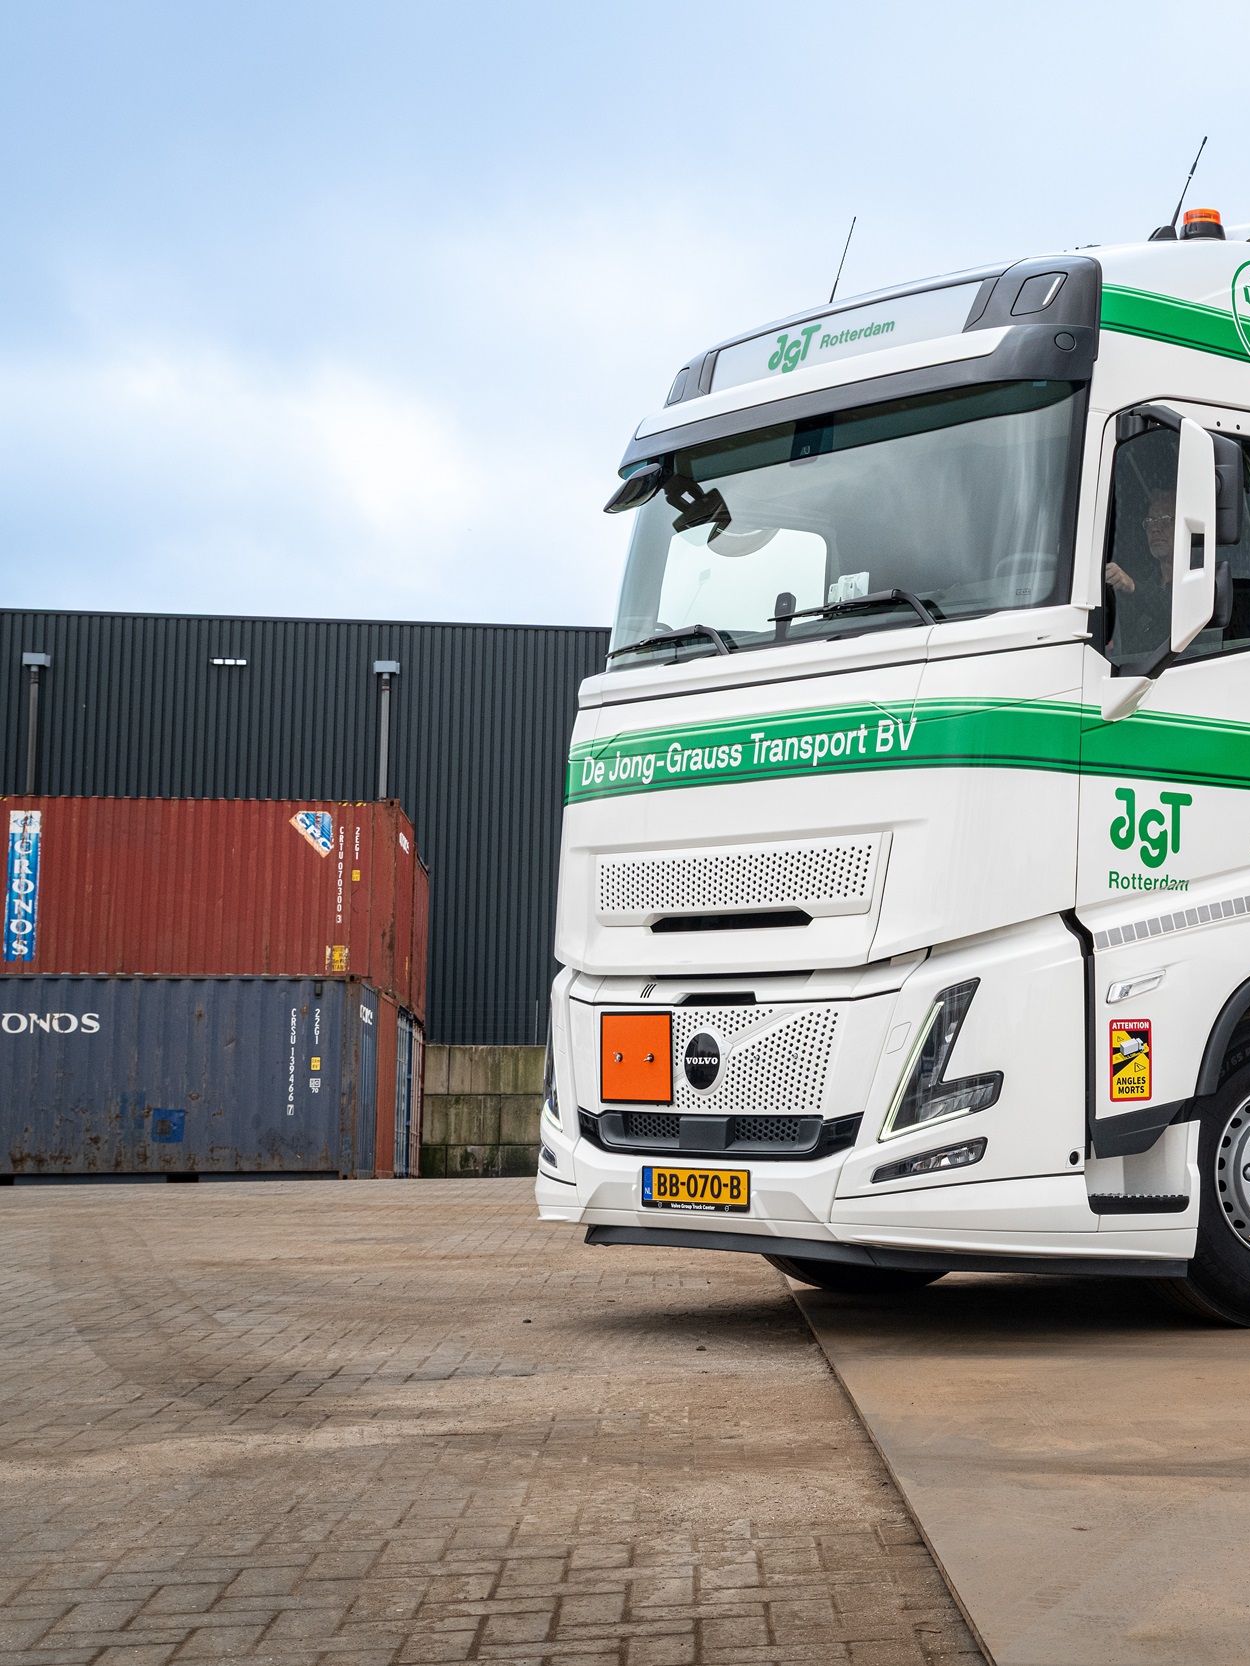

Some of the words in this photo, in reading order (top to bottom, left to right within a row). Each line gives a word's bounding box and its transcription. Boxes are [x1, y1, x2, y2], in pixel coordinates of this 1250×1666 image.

[819, 320, 895, 350] Rotterdam
[581, 756, 605, 786] De
[609, 742, 742, 784] Jong-Grauss
[750, 724, 868, 766] Transport
[875, 717, 918, 753] BV
[1108, 870, 1190, 892] Rotterdam
[10, 839, 35, 955] CRONOS
[2, 1013, 100, 1034] ONOS
[685, 1057, 719, 1065] VOLVO
[1116, 1076, 1146, 1085] ANGLES
[1118, 1086, 1145, 1094] MORTS
[287, 1104, 294, 1115] 7
[644, 1187, 652, 1195] NL
[657, 1173, 741, 1199] BB-070-B
